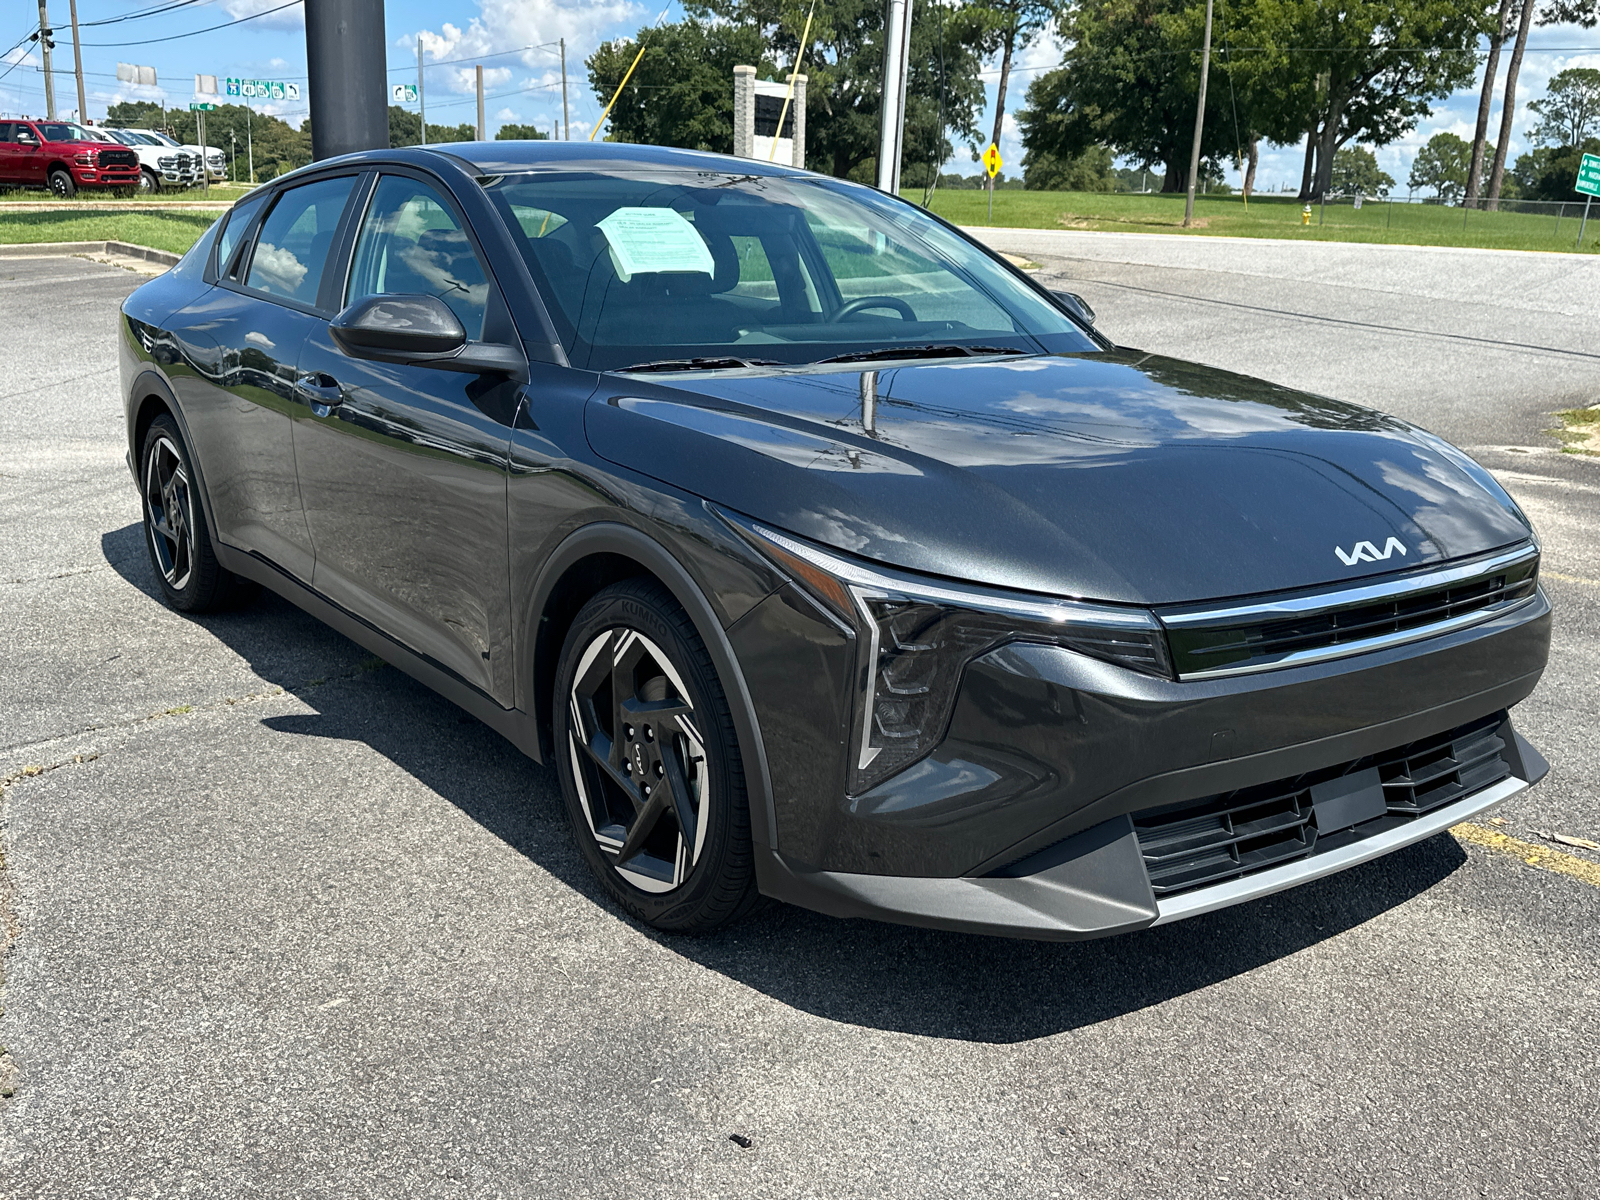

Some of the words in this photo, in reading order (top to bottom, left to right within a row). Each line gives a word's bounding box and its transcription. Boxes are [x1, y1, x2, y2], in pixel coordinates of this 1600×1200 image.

[245, 86, 252, 95] 41
[1334, 536, 1408, 566] KIA
[621, 600, 668, 637] KUMHO
